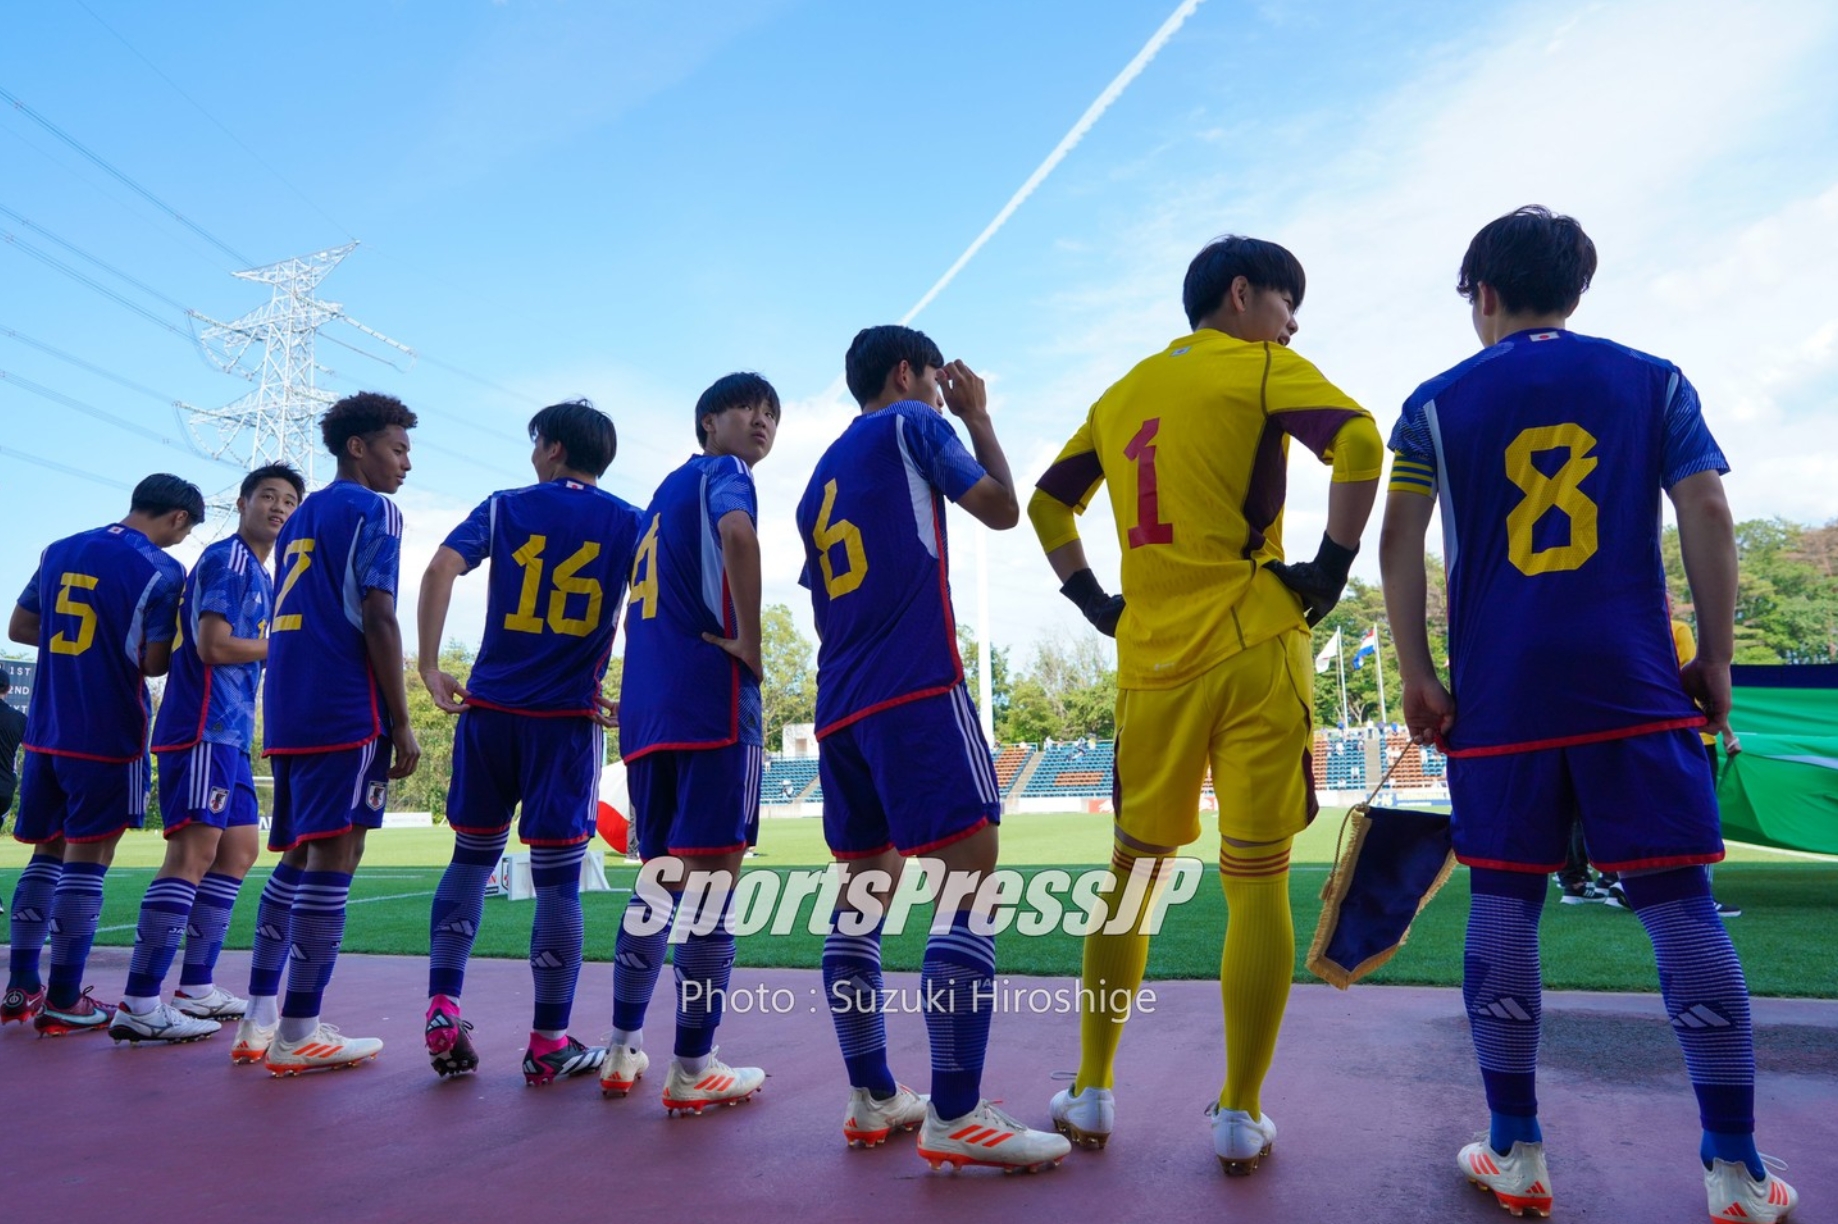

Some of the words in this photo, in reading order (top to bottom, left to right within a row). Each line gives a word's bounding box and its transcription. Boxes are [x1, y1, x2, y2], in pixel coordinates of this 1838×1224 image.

[1123, 418, 1173, 549] 1
[1504, 422, 1599, 577] 8
[272, 538, 315, 632] 2
[503, 534, 604, 638] 16
[629, 512, 660, 620] 4
[812, 480, 869, 600] 6
[49, 572, 99, 656] 5
[10, 666, 31, 676] 1ST
